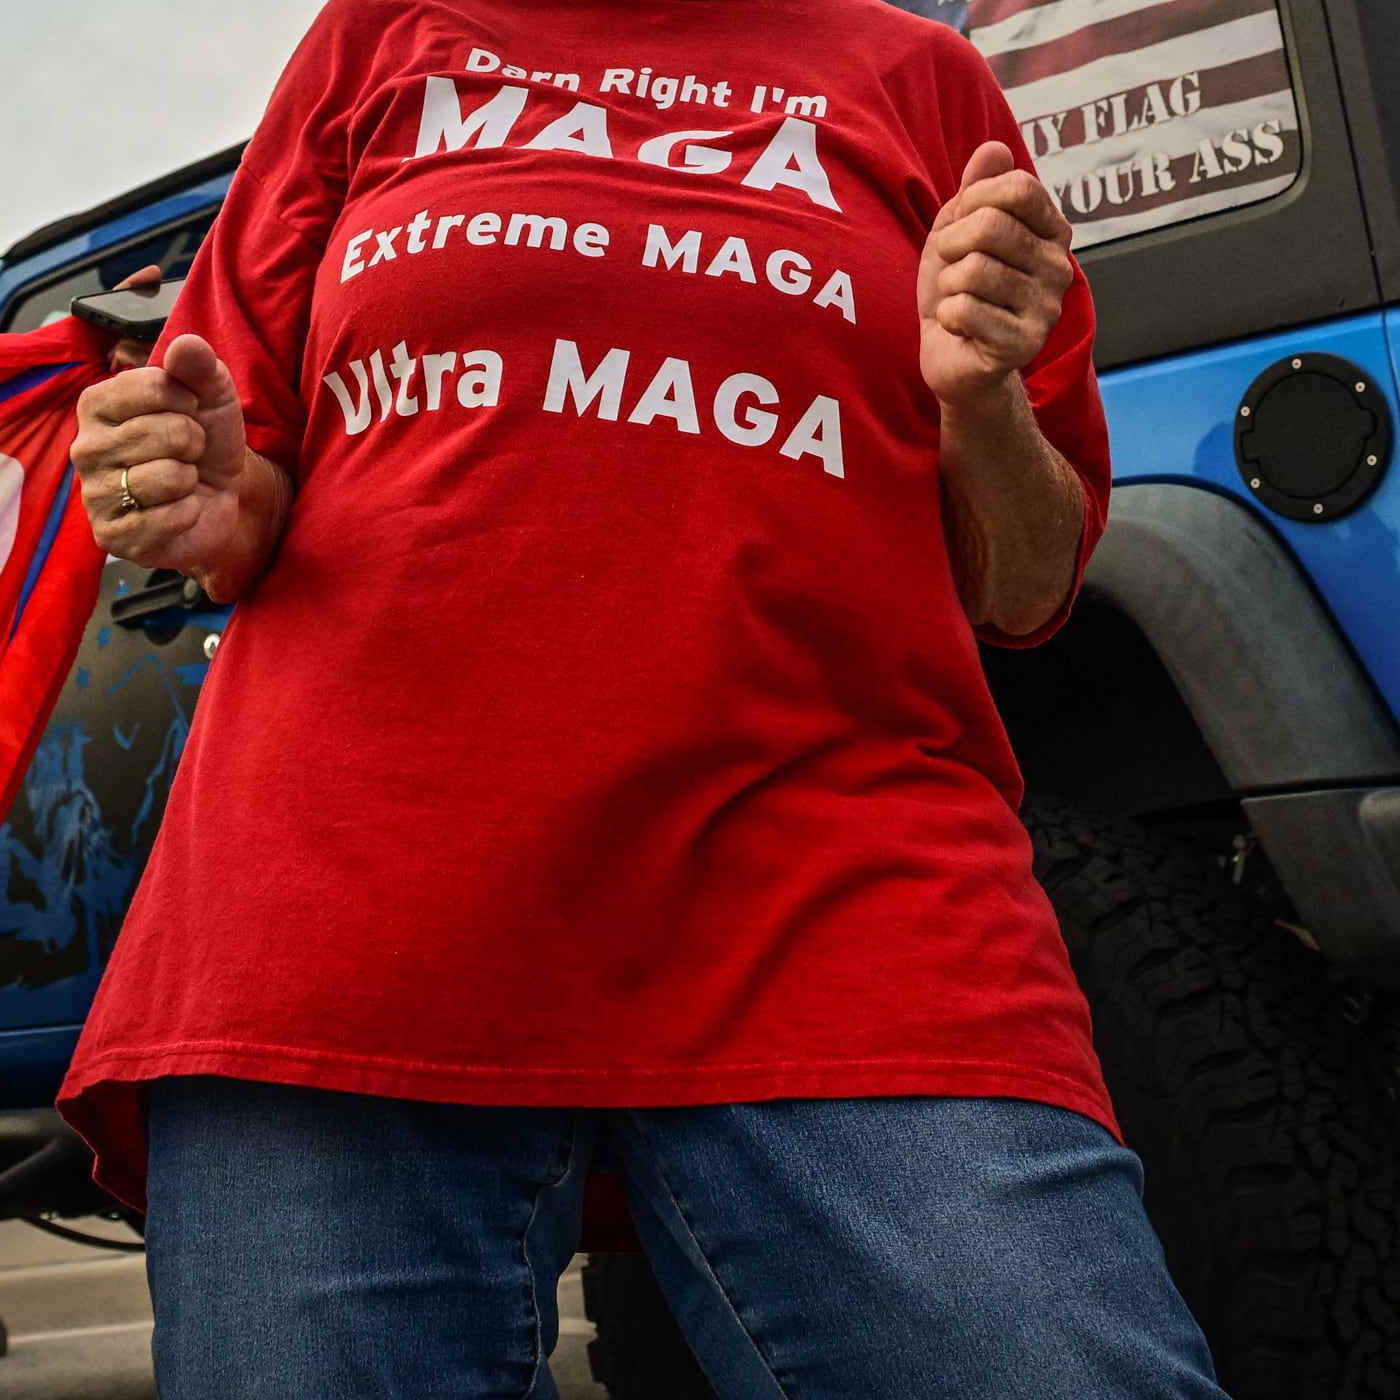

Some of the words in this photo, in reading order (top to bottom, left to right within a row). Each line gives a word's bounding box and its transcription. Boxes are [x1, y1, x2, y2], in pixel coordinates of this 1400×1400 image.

[465, 47, 581, 93] Darn
[599, 67, 732, 110] Right
[749, 85, 828, 118] I'm
[1081, 71, 1201, 145] FLAG
[401, 75, 843, 214] MAGA
[1050, 152, 1176, 215] YOUR
[1188, 119, 1284, 184] ASS
[340, 208, 610, 284] Extreme
[641, 223, 857, 326] MAGA
[322, 341, 504, 437] Ultra
[541, 338, 845, 480] MAGA
